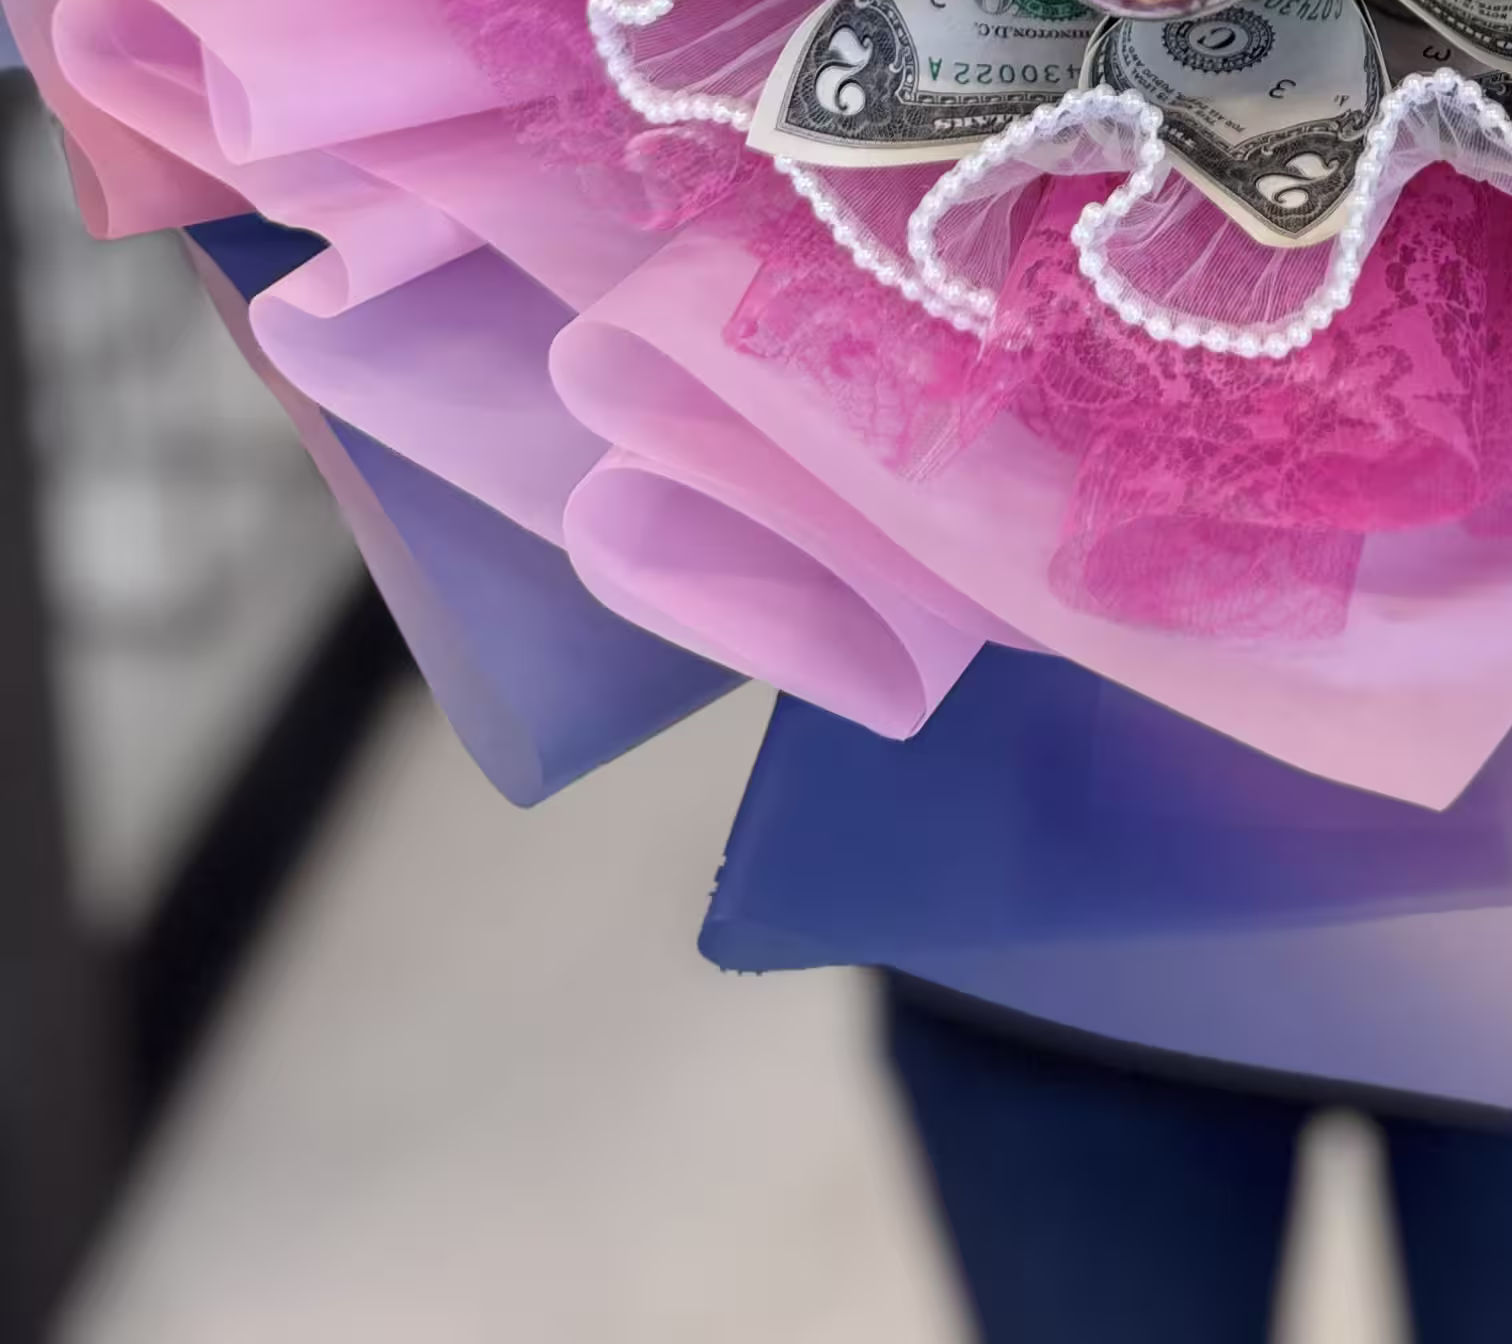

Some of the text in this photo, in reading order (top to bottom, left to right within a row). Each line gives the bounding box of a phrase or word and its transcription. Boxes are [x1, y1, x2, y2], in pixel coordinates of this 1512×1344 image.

[1422, 45, 1451, 62] 3
[814, 25, 874, 116] 2
[928, 56, 1084, 85] 430022 A
[1267, 78, 1297, 100] 3
[1254, 150, 1341, 210] 2
